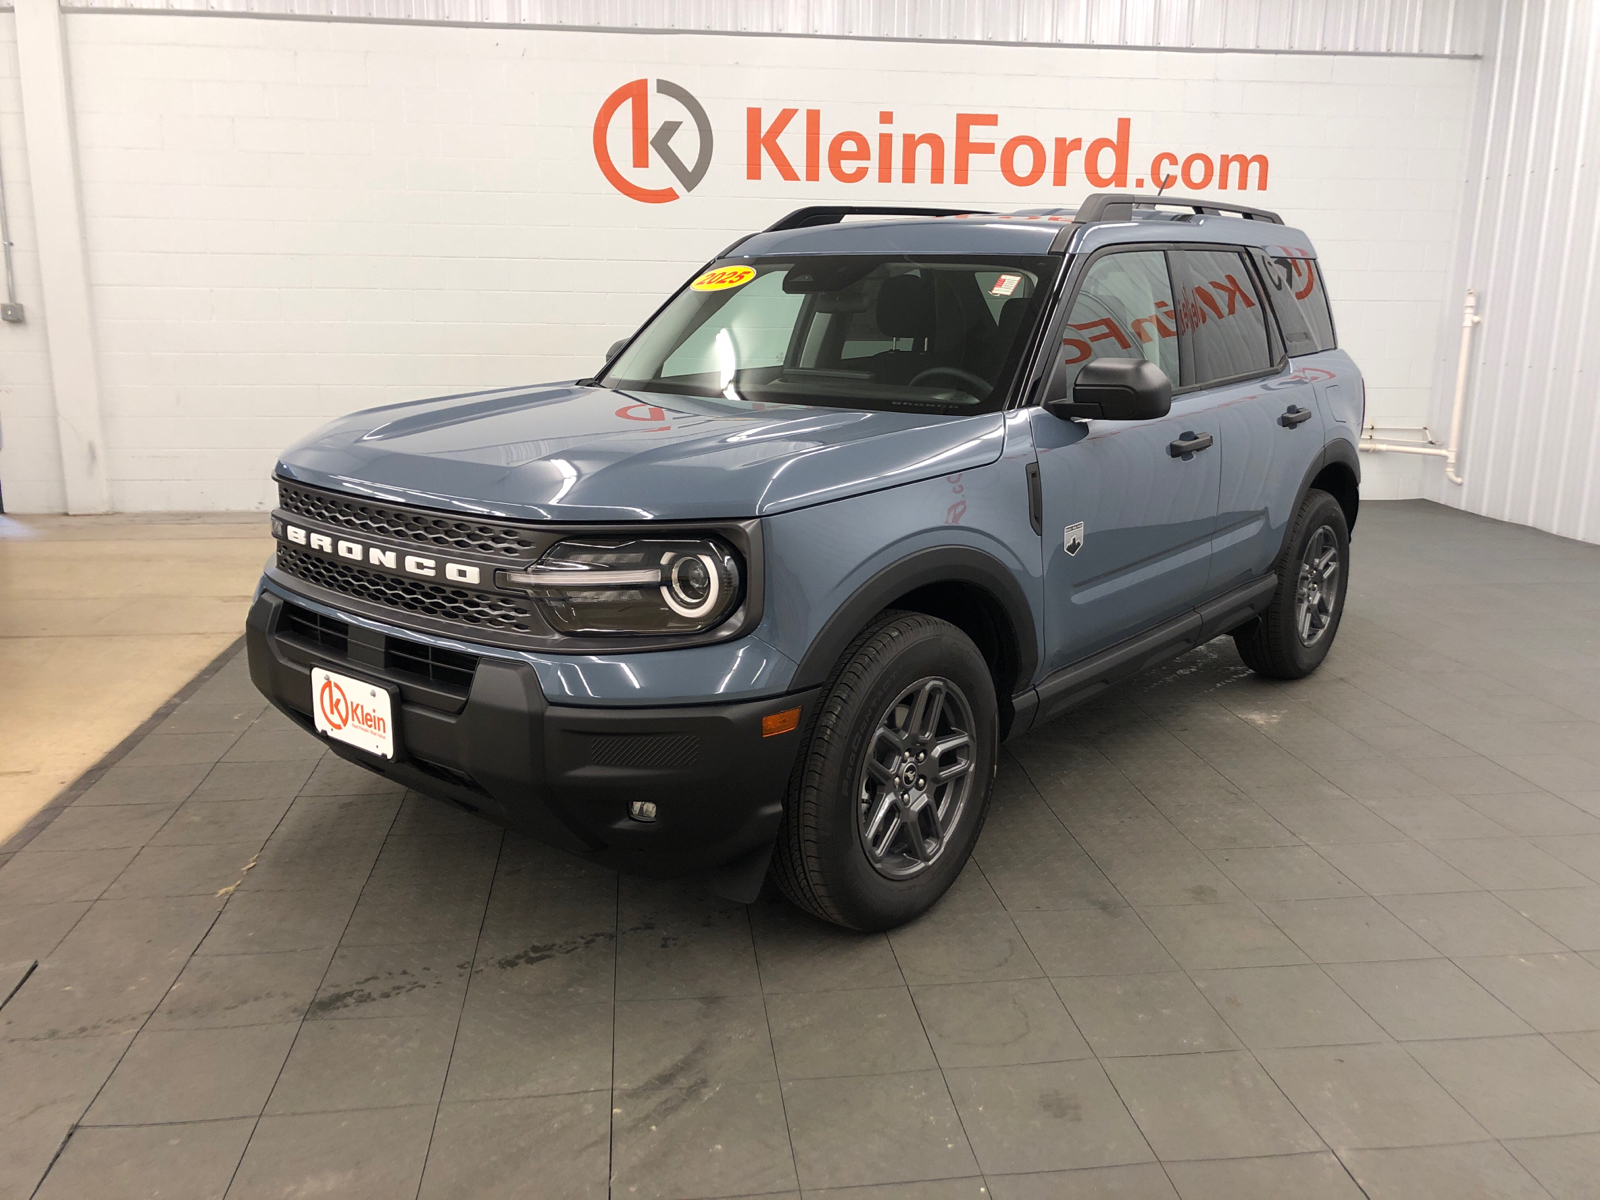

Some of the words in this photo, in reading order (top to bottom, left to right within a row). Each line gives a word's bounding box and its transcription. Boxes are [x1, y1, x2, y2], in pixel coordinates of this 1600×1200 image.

[746, 106, 1268, 192] KleinFord.com
[695, 271, 752, 285] 2025
[286, 524, 481, 585] BRONCO
[350, 701, 386, 733] Klein
